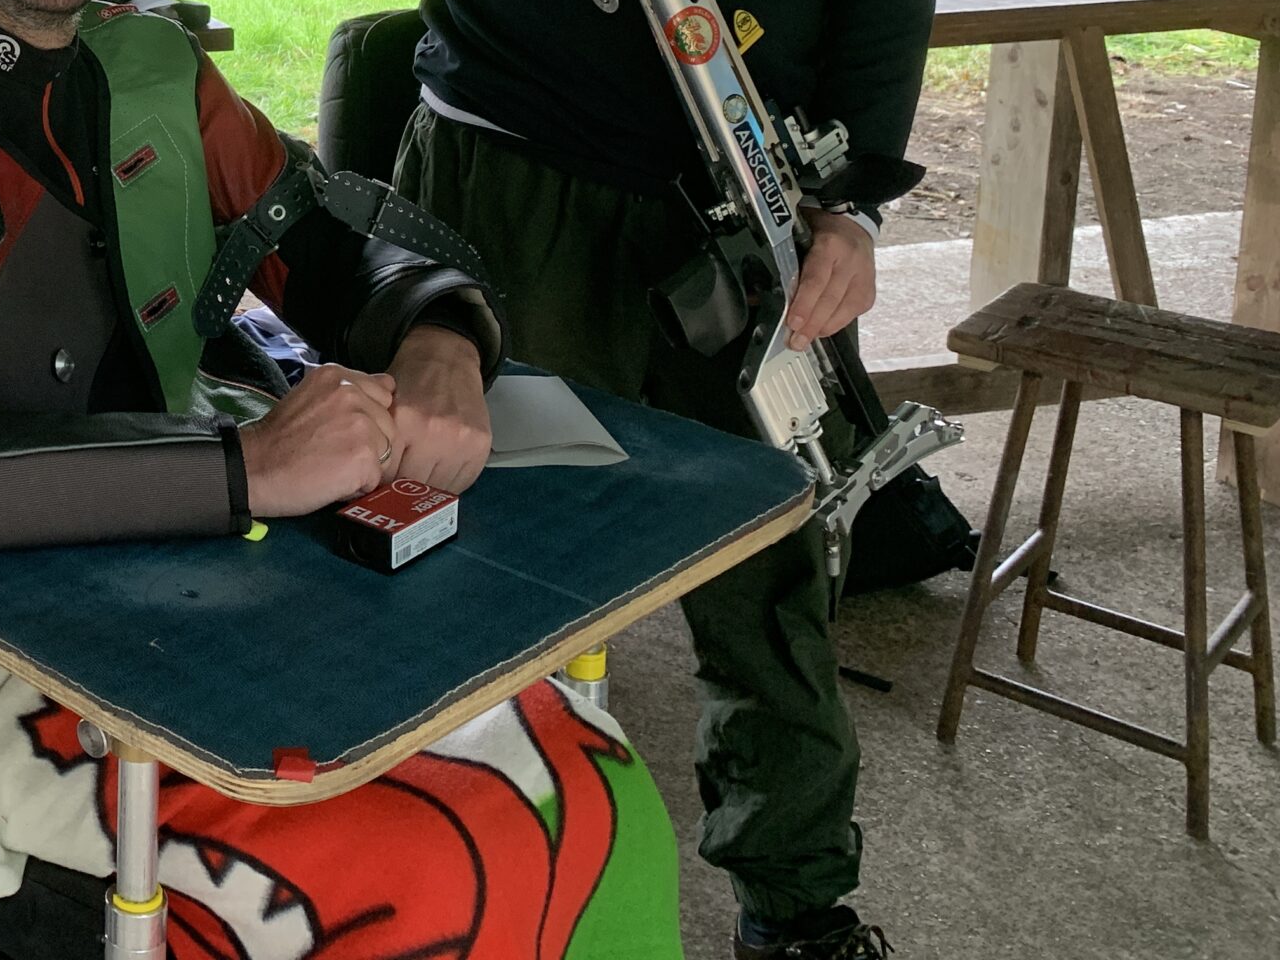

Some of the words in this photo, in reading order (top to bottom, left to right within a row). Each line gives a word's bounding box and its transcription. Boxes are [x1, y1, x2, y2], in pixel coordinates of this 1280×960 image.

[735, 130, 791, 224] ANSCHÜTZ
[411, 492, 454, 513] tenex
[344, 506, 405, 530] ELEY
